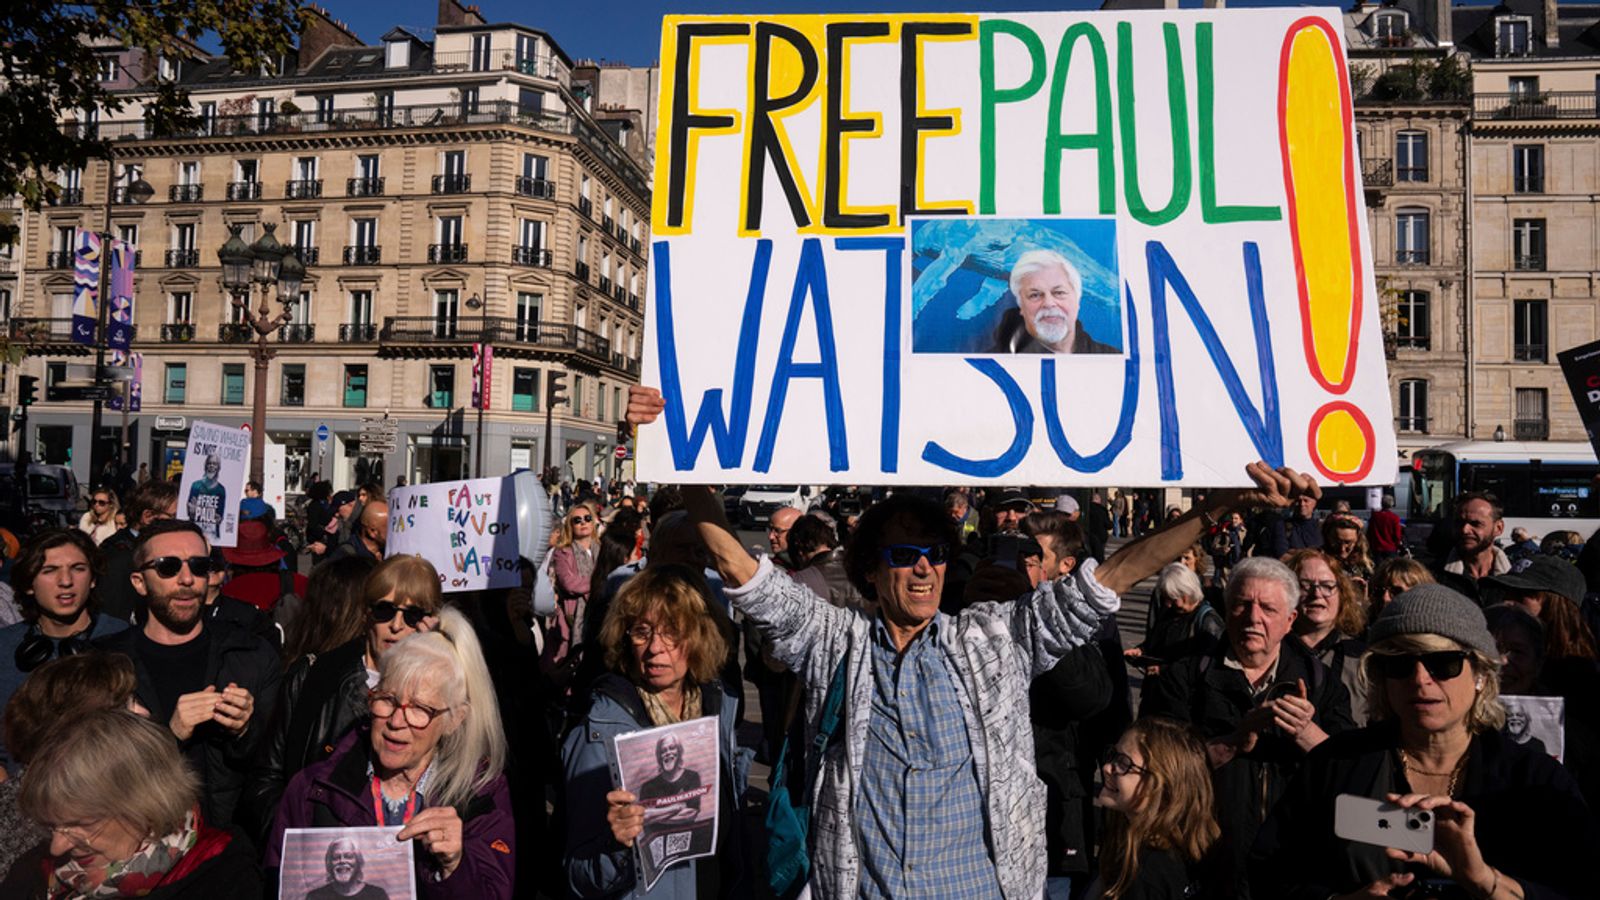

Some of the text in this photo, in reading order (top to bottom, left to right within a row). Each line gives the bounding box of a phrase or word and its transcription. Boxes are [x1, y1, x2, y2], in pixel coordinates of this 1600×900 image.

[192, 424, 249, 449] SAVING WHALES
[193, 441, 202, 455] IS
[407, 494, 429, 508] NE
